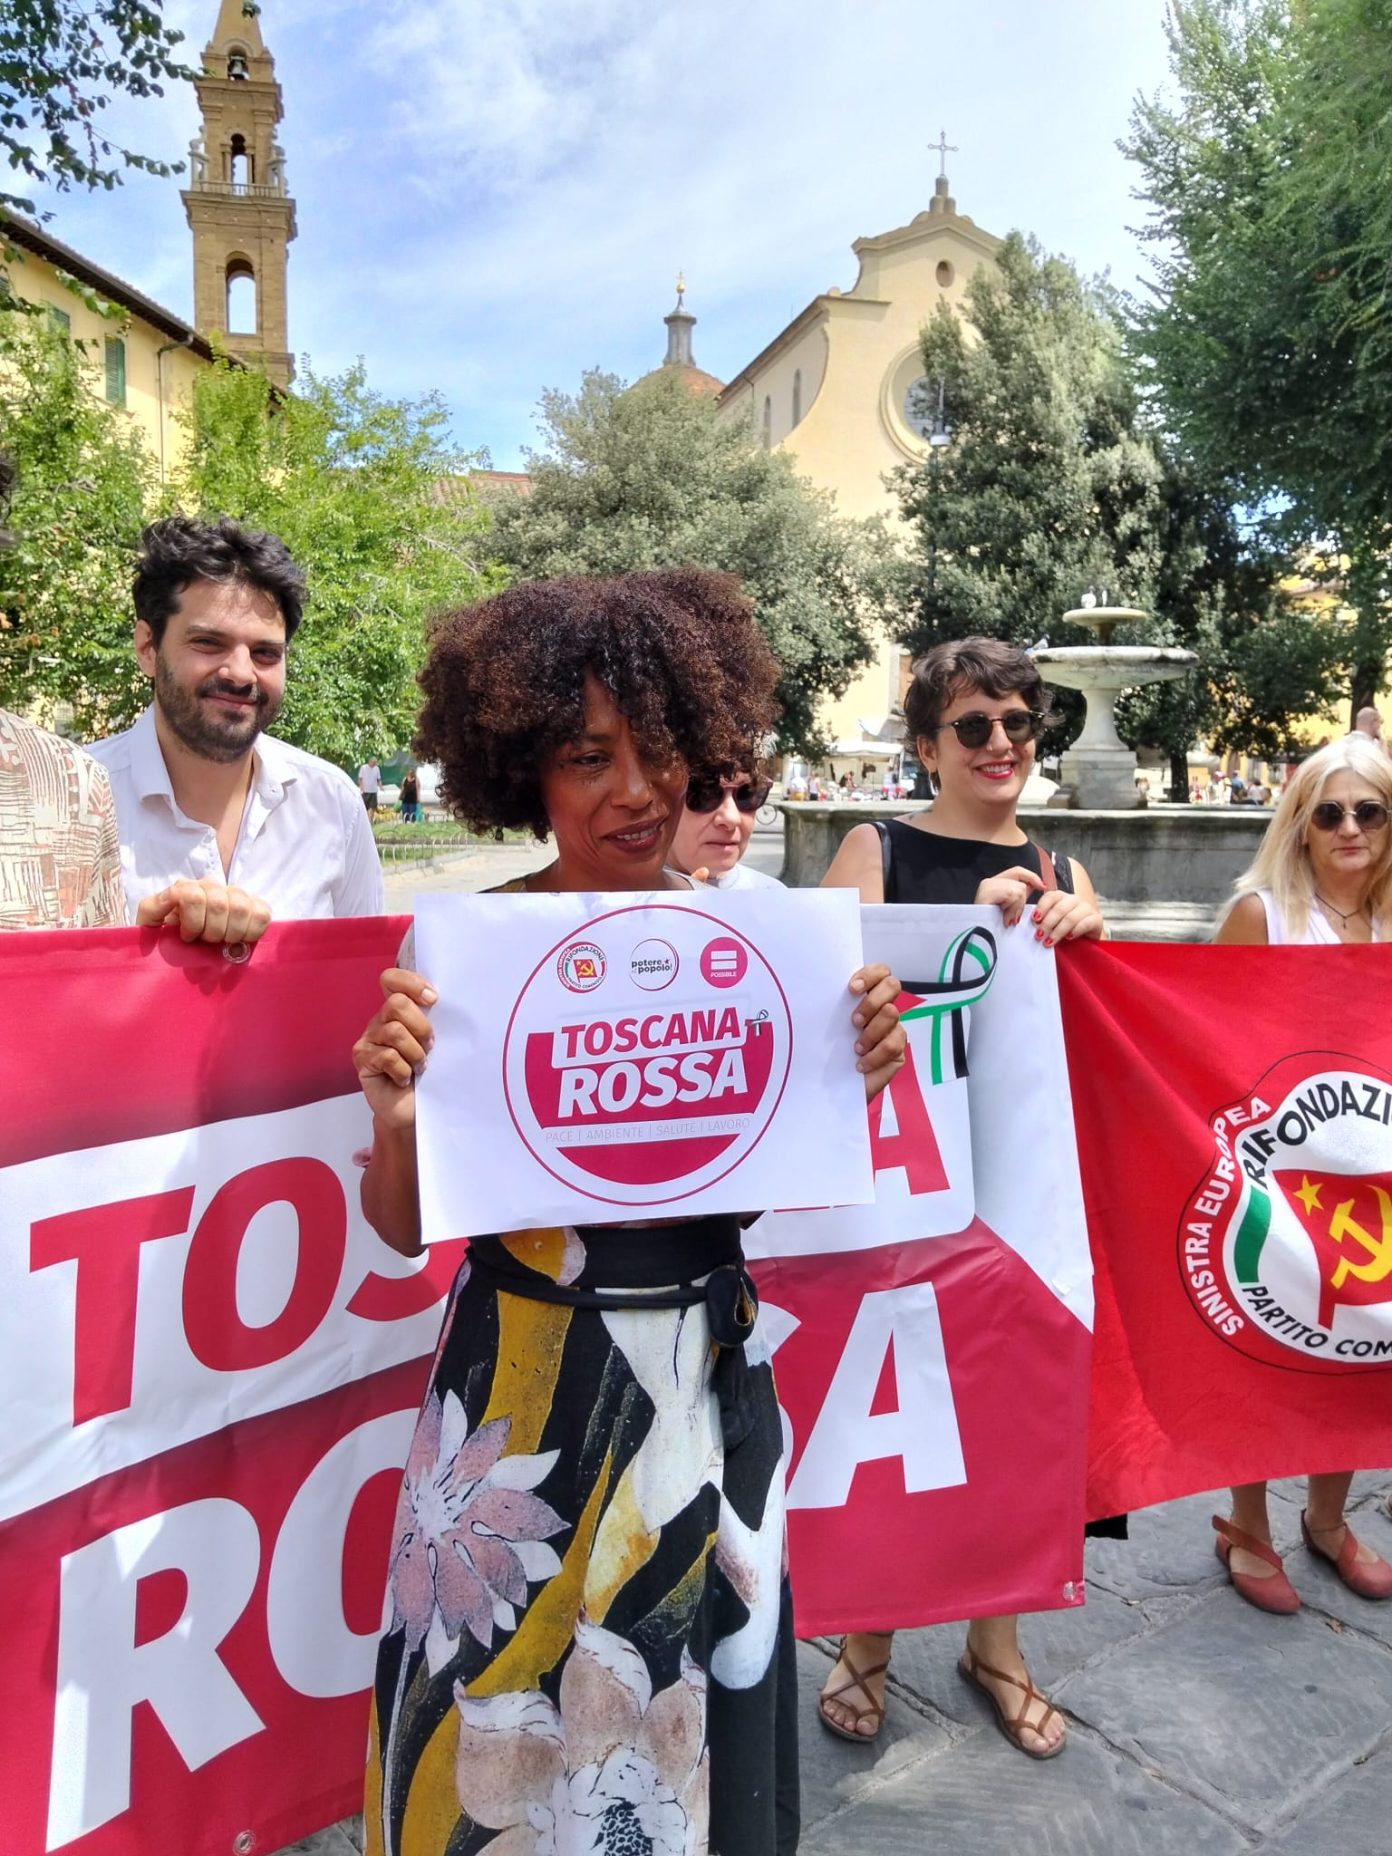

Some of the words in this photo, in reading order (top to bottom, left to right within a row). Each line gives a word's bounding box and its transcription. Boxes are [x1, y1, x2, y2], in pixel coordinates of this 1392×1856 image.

[631, 959, 662, 969] potere
[561, 1007, 740, 1059] TOSCANA
[557, 1048, 748, 1119] ROSSA
[545, 1130, 574, 1143] PACE
[586, 1126, 644, 1141] AMBIENTE
[656, 1122, 696, 1136] SALUTE
[707, 1117, 750, 1131] LAVORO
[1194, 1096, 1272, 1217] EUROPEA
[1185, 1222, 1244, 1336] SINISTRA
[1243, 1285, 1328, 1349] PARTITO
